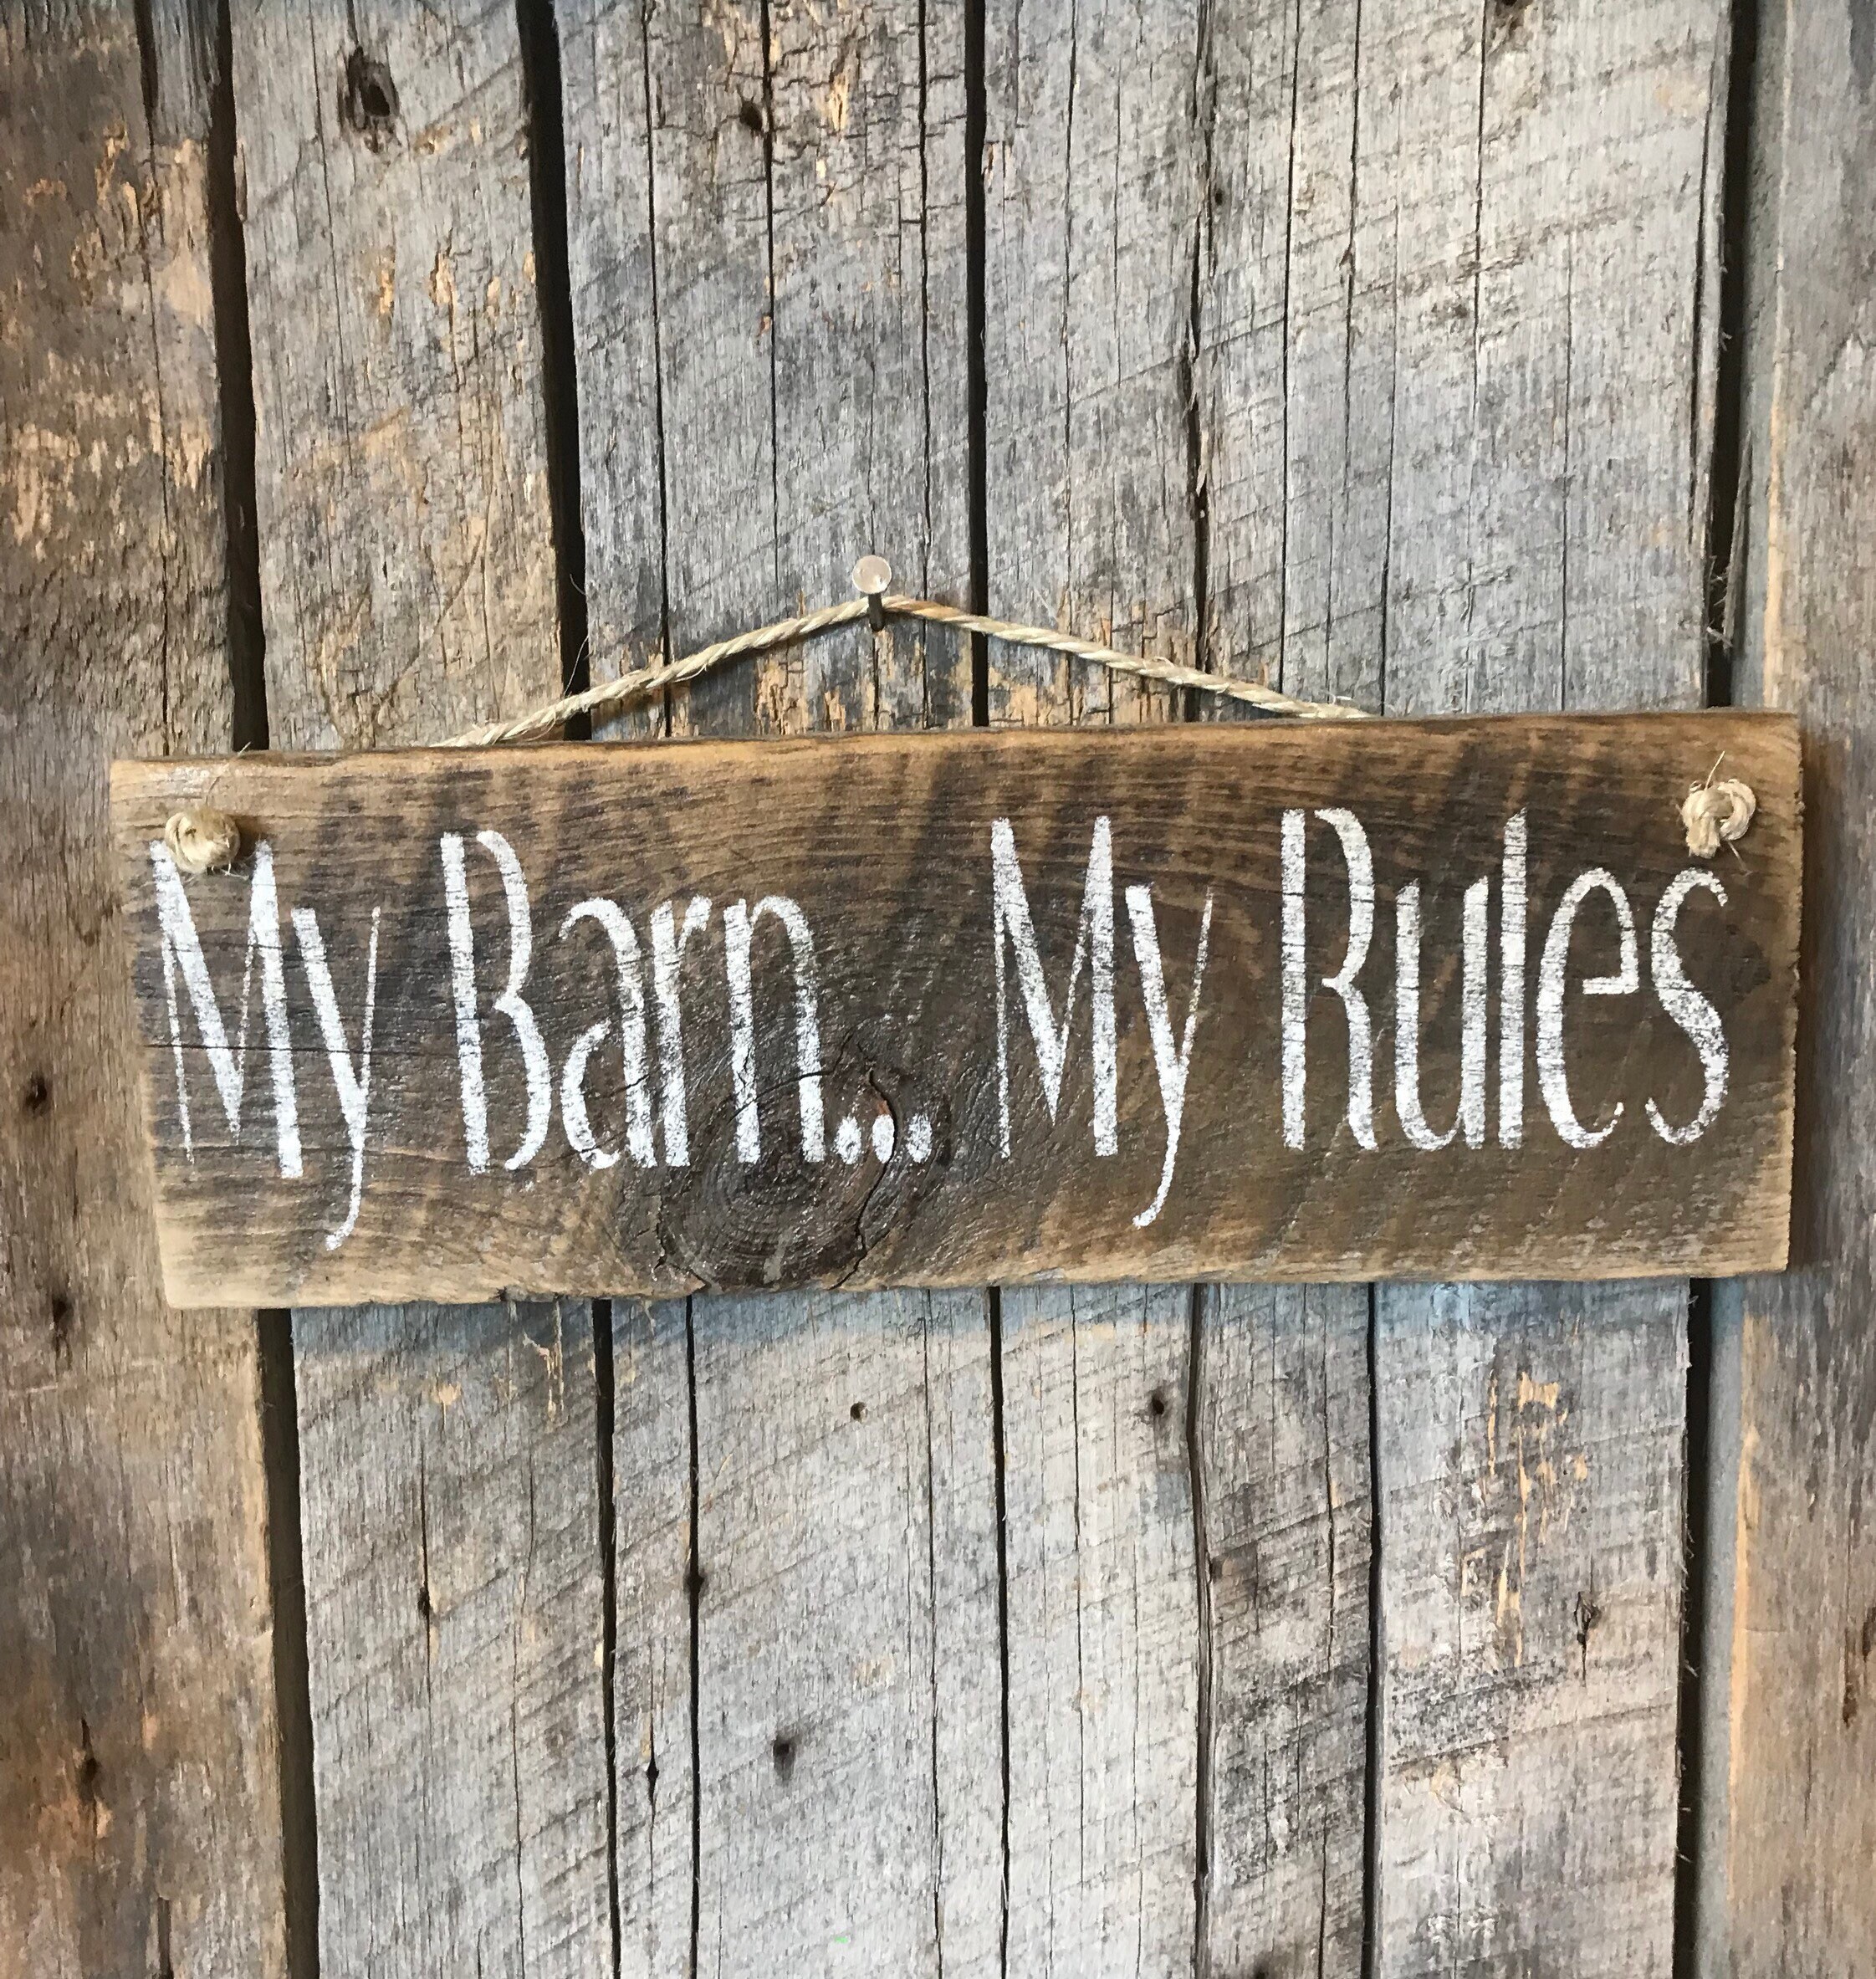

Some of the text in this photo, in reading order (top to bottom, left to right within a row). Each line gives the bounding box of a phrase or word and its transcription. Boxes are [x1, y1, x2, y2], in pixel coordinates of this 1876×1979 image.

[150, 808, 1729, 1251] My Barn... My Rules
